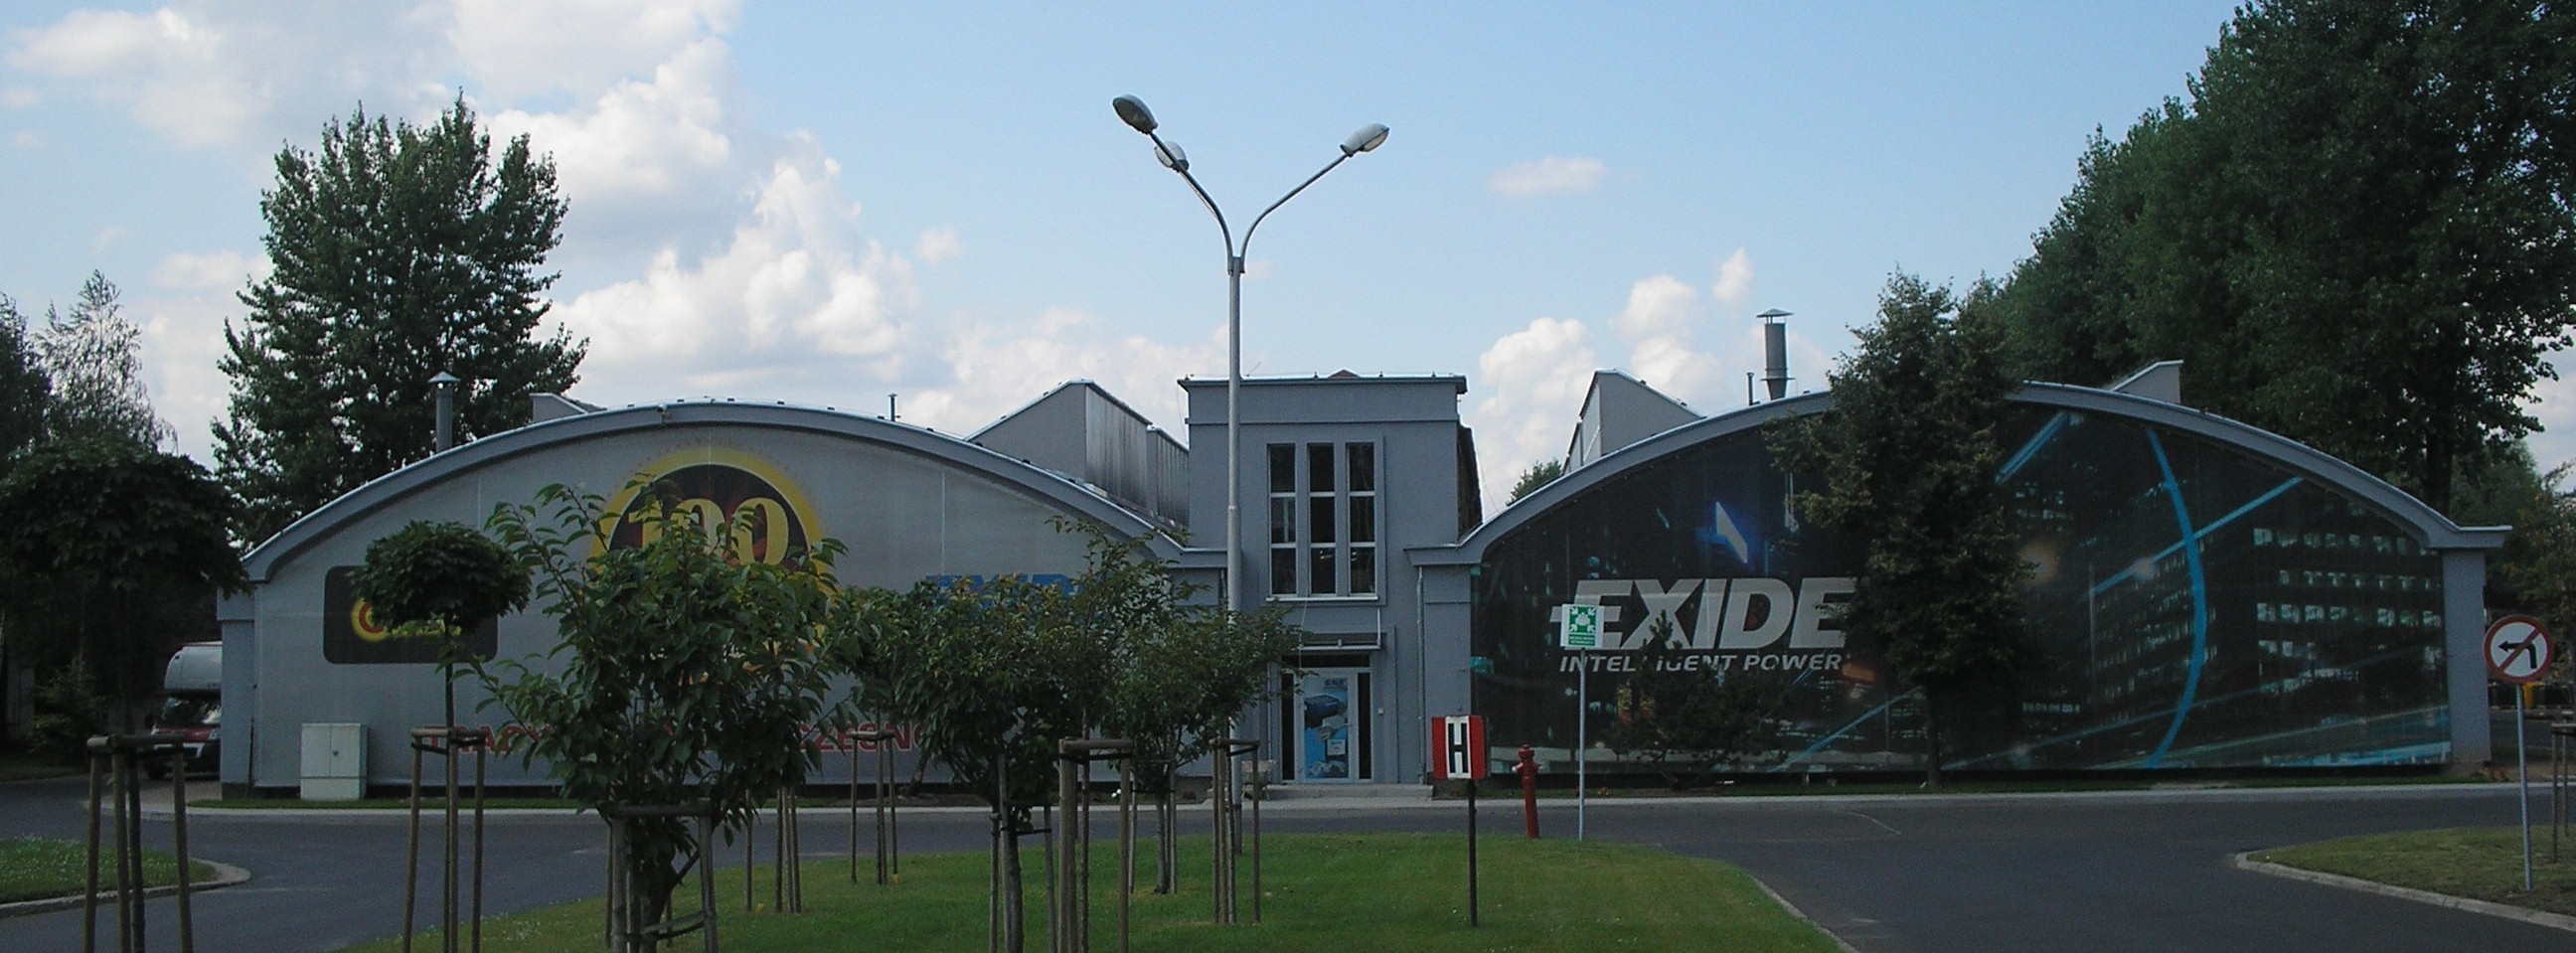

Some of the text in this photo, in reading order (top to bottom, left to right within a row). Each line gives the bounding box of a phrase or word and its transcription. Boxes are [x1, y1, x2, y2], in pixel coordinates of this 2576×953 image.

[628, 497, 790, 566] 100
[1549, 576, 1857, 650] EXIDE
[1559, 654, 1843, 672] INTELIGENT POWER
[1448, 723, 1468, 773] H
